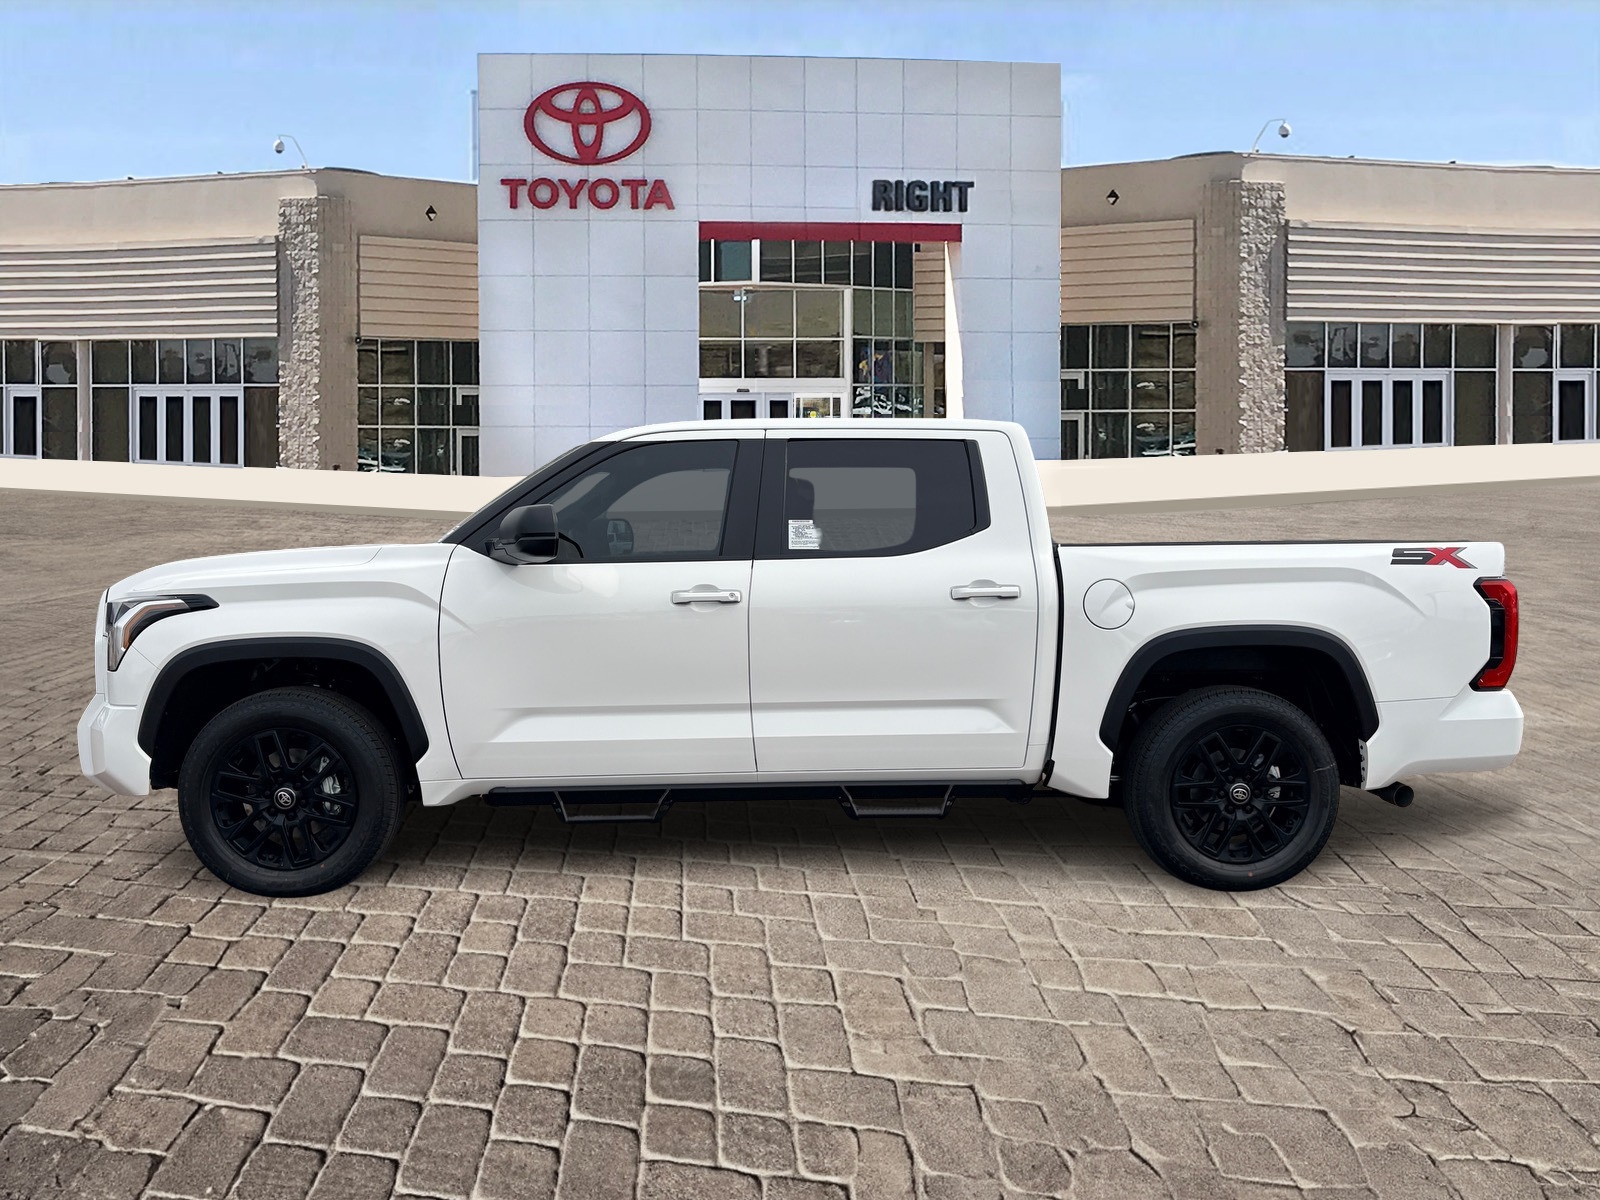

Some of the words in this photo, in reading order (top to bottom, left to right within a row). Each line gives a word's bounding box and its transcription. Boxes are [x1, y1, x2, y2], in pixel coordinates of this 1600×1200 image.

[500, 178, 676, 211] TOYOTA
[871, 179, 975, 213] RIGHT
[1390, 547, 1478, 569] SX
